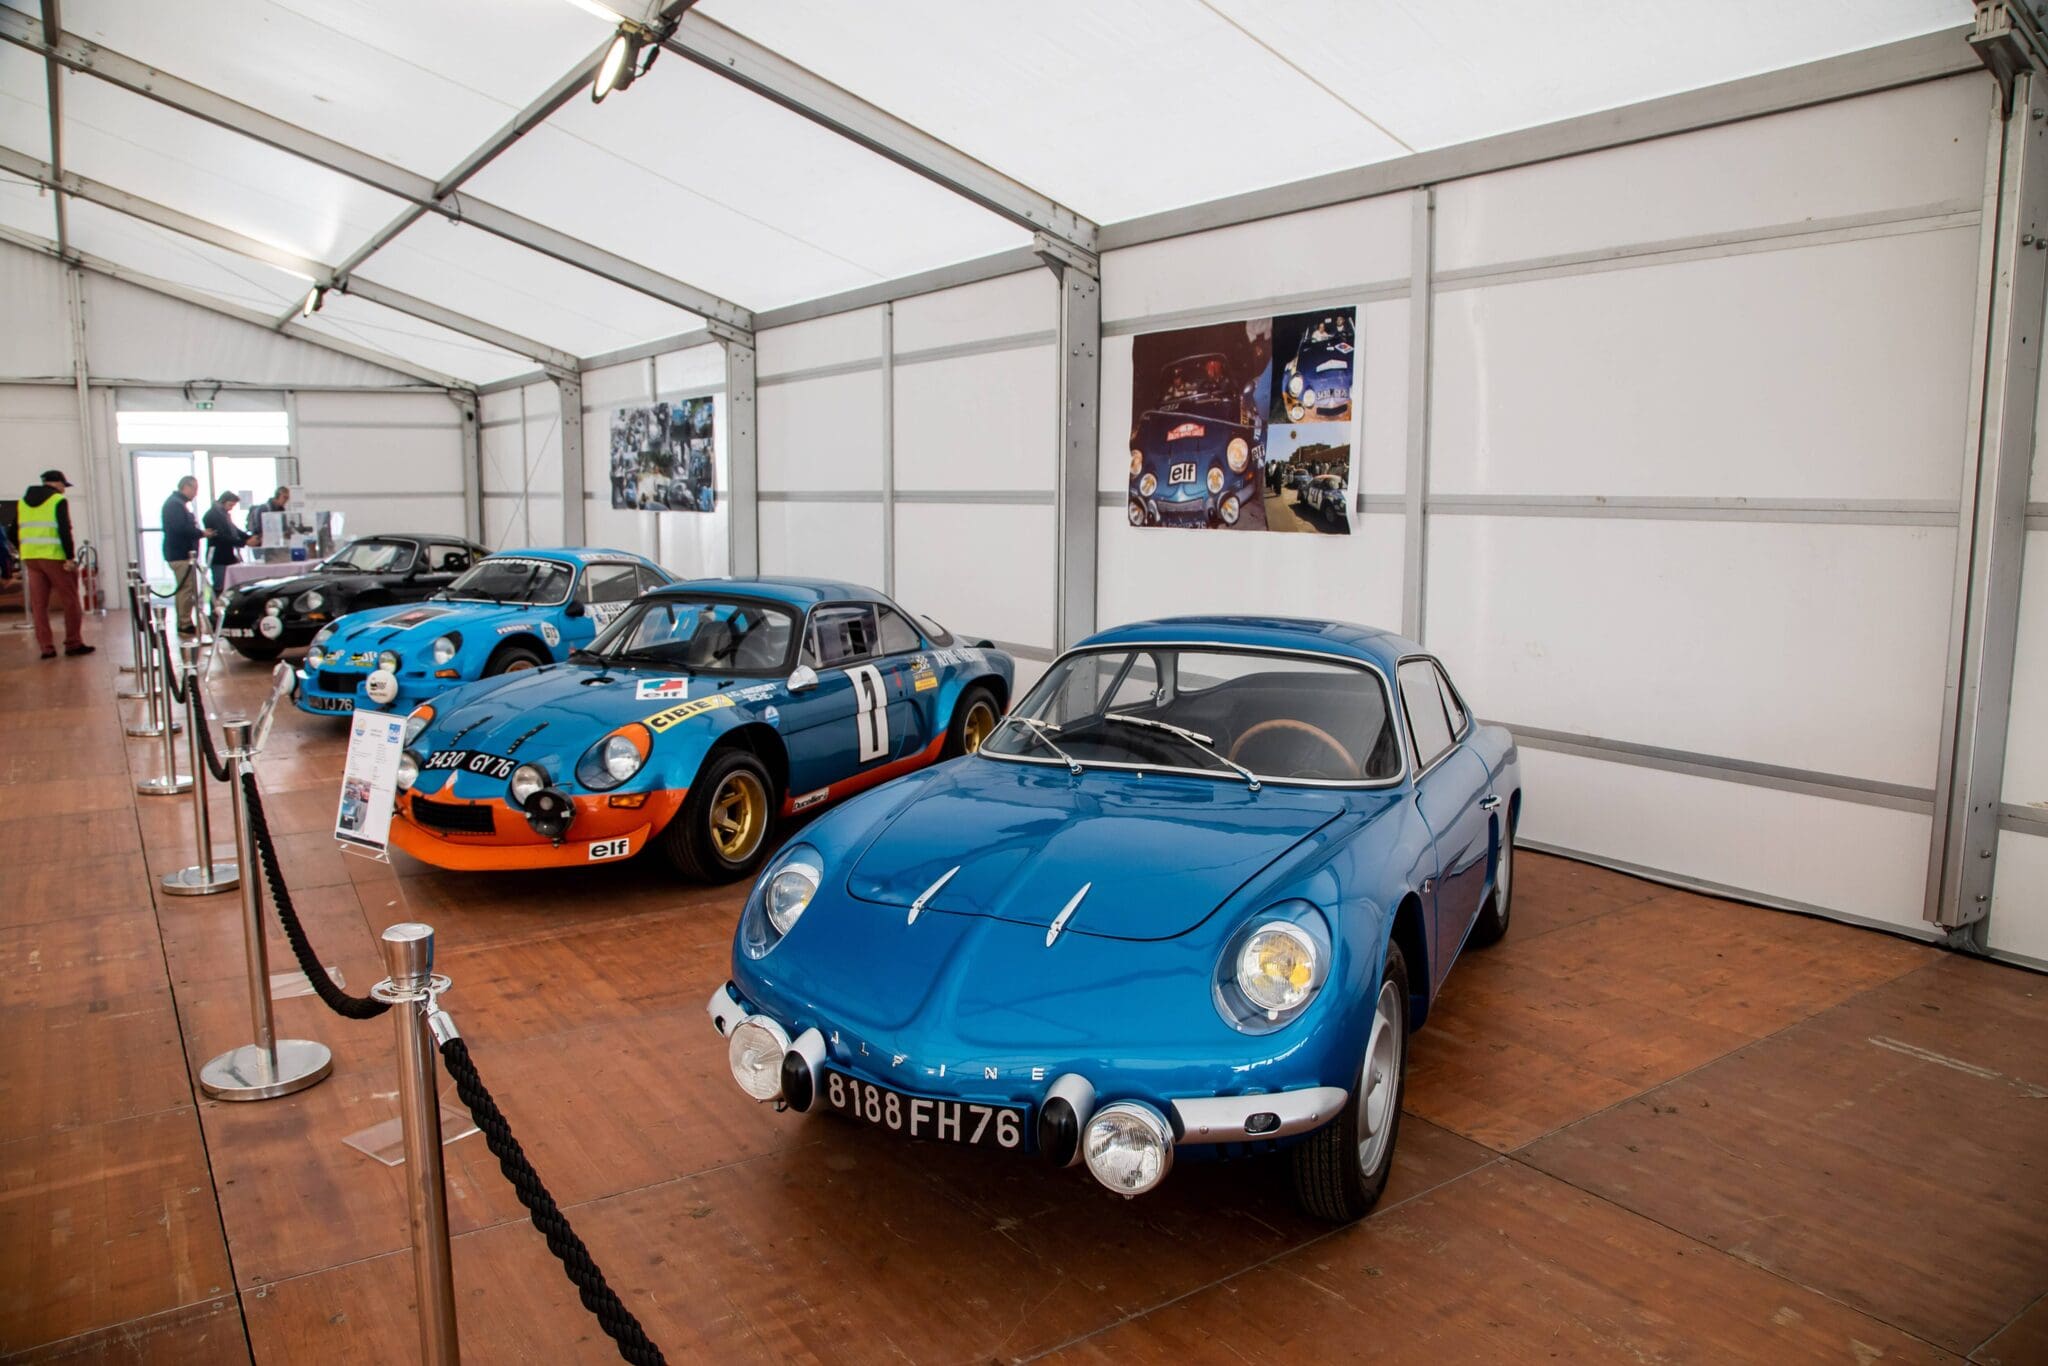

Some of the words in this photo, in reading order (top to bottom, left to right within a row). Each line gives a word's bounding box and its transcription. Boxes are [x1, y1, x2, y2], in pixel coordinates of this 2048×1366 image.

[1171, 464, 1194, 482] elf
[339, 698, 353, 710] 76
[650, 700, 712, 728] CIBIE
[861, 670, 879, 752] 1
[425, 751, 466, 769] 3430
[468, 754, 493, 772] GY
[491, 758, 515, 778] 76
[591, 838, 628, 858] elf
